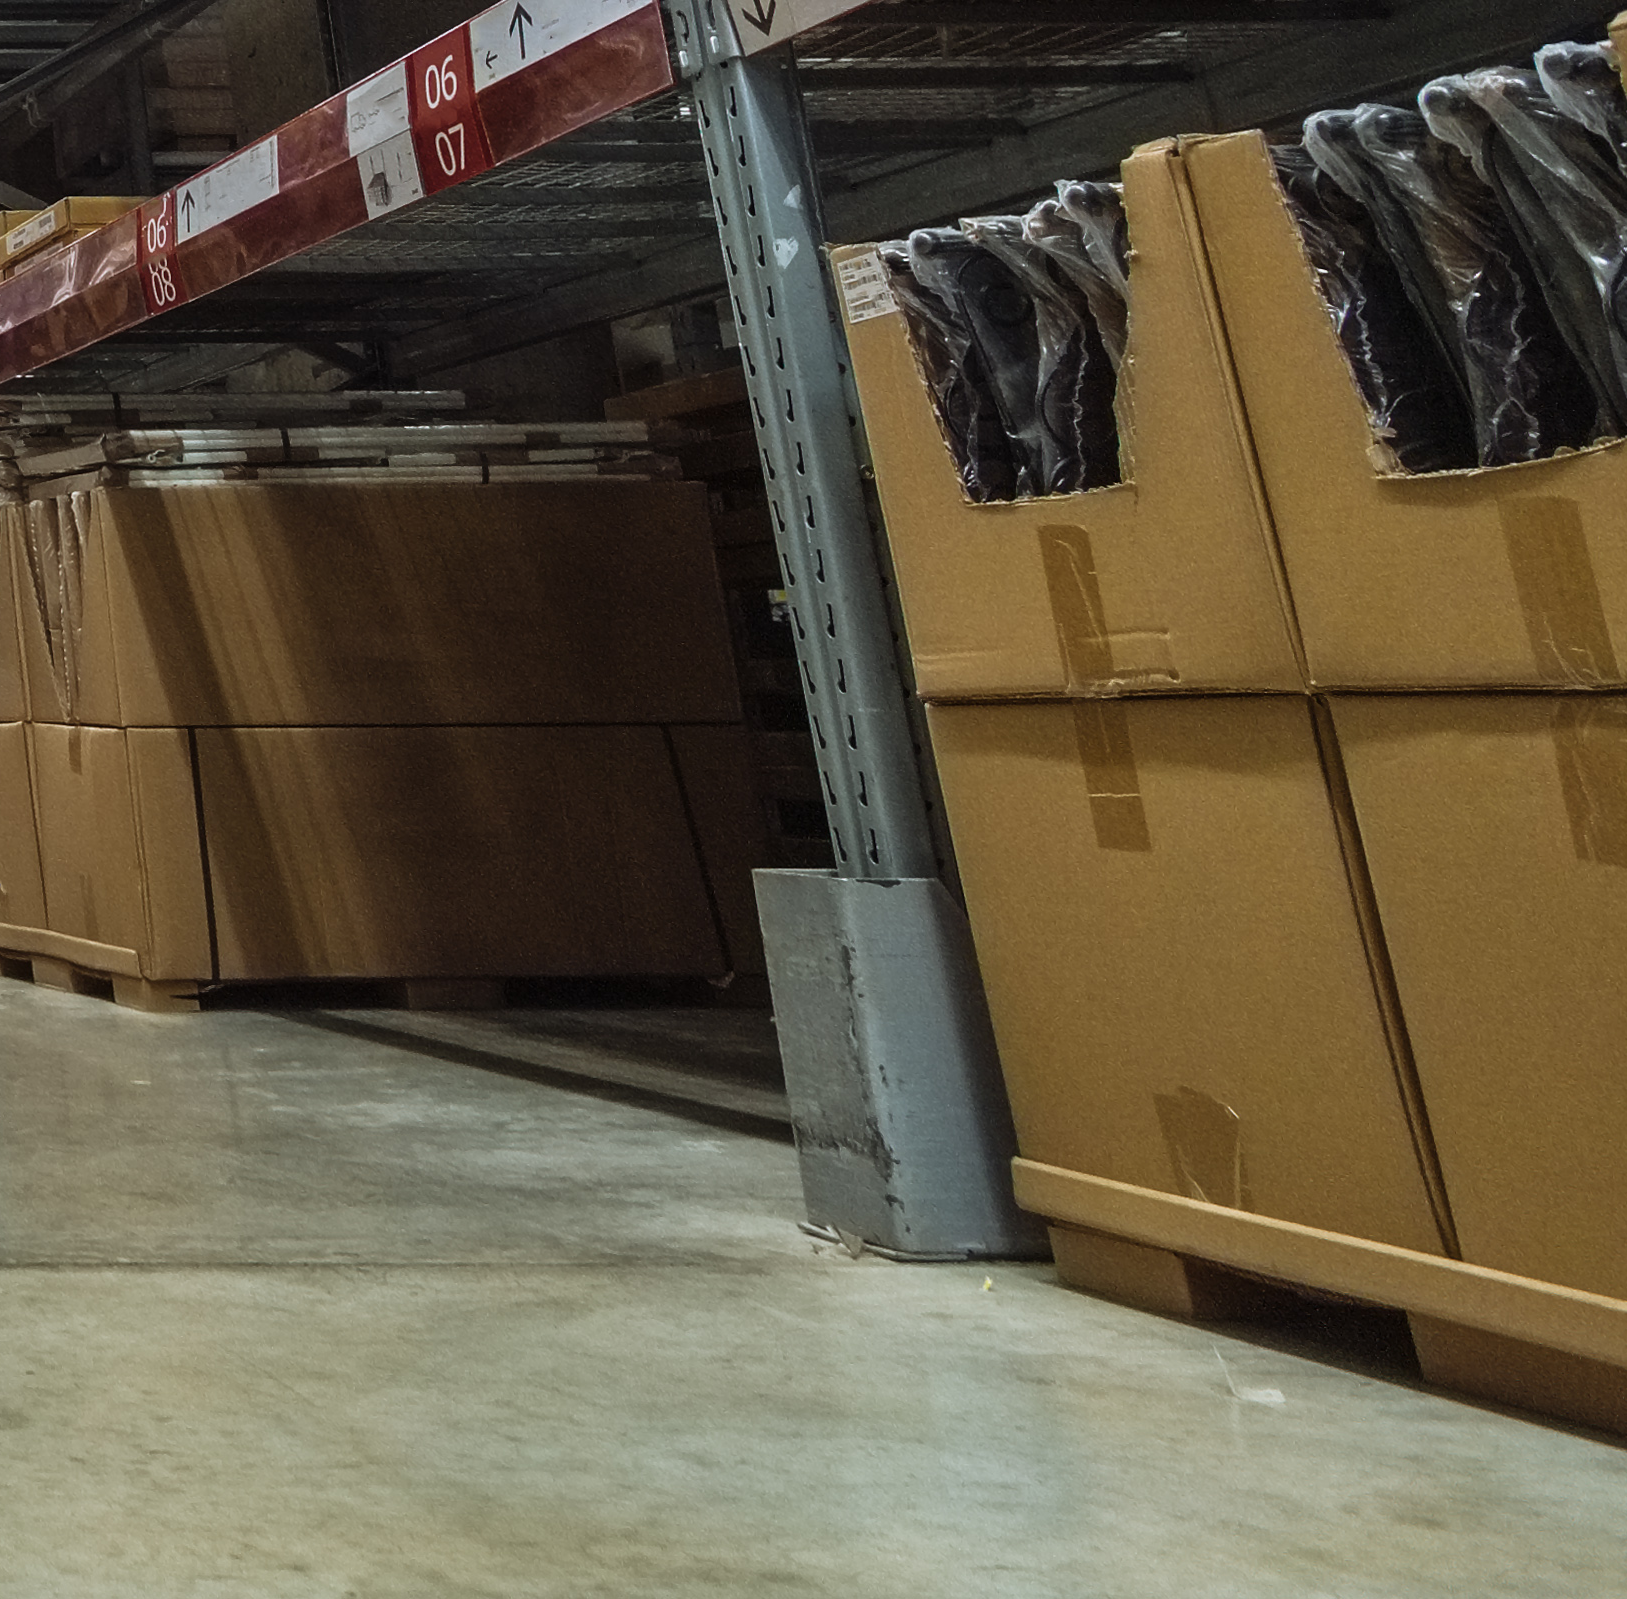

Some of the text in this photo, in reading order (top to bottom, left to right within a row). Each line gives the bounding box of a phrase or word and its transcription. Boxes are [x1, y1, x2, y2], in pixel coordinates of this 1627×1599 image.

[425, 54, 458, 109] 06
[435, 122, 465, 176] 07
[147, 212, 167, 253] 06
[151, 265, 176, 306] 08
